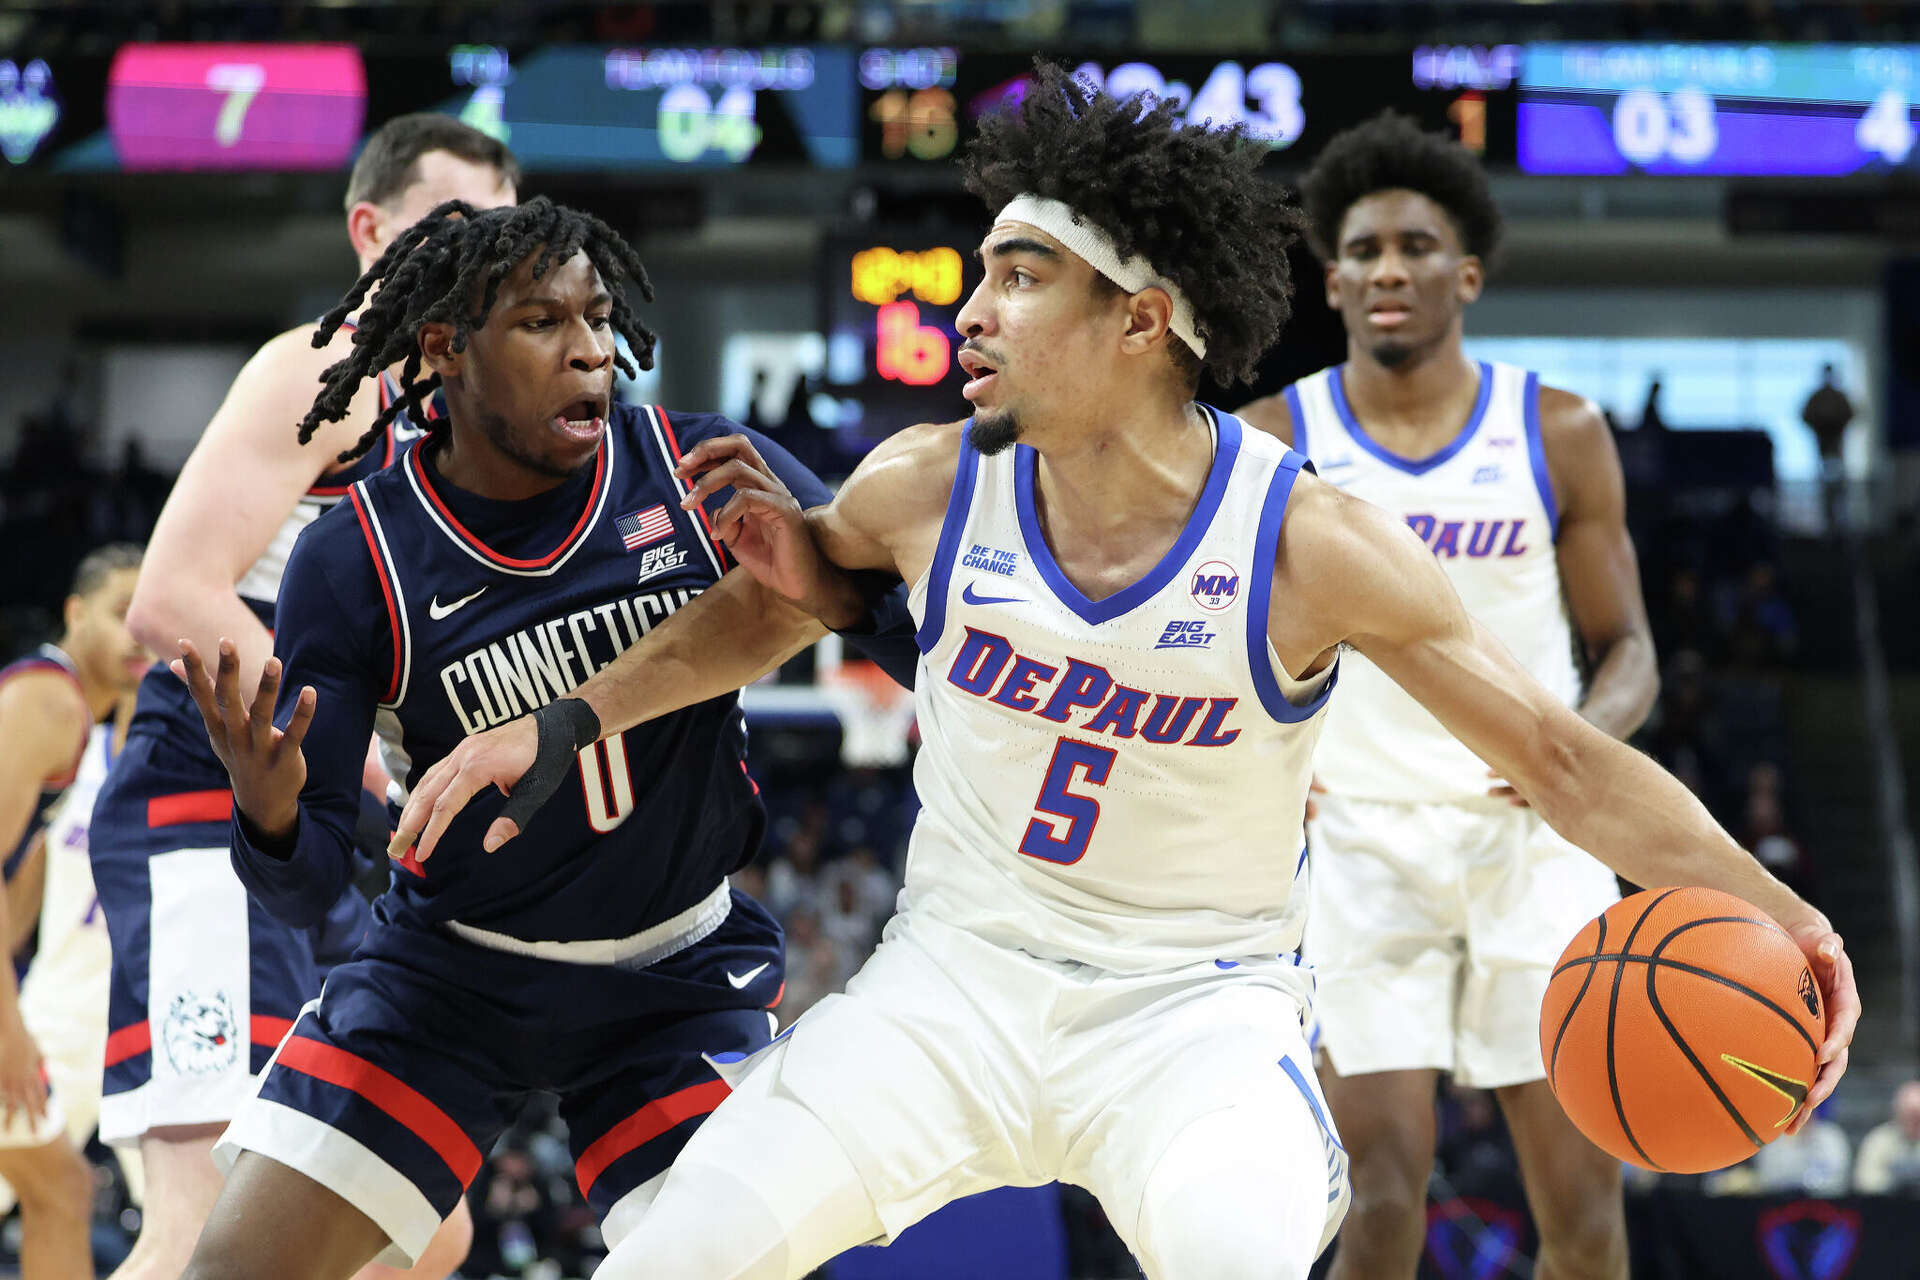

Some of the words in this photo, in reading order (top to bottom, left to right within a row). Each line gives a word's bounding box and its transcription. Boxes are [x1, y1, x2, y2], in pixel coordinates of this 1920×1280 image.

[206, 62, 267, 148] 7
[657, 83, 760, 163] 04
[1613, 88, 1719, 164] 03
[1856, 89, 1917, 163] 4
[639, 550, 688, 577] EAST
[642, 542, 676, 565] BIG
[970, 544, 991, 557] BE
[992, 549, 1018, 563] THE
[962, 554, 1017, 577] CHANGE
[1191, 574, 1239, 597] MM
[1209, 597, 1221, 606] 33
[1165, 620, 1206, 633] BIG
[1158, 632, 1216, 645] EAST
[1018, 736, 1118, 866] 5
